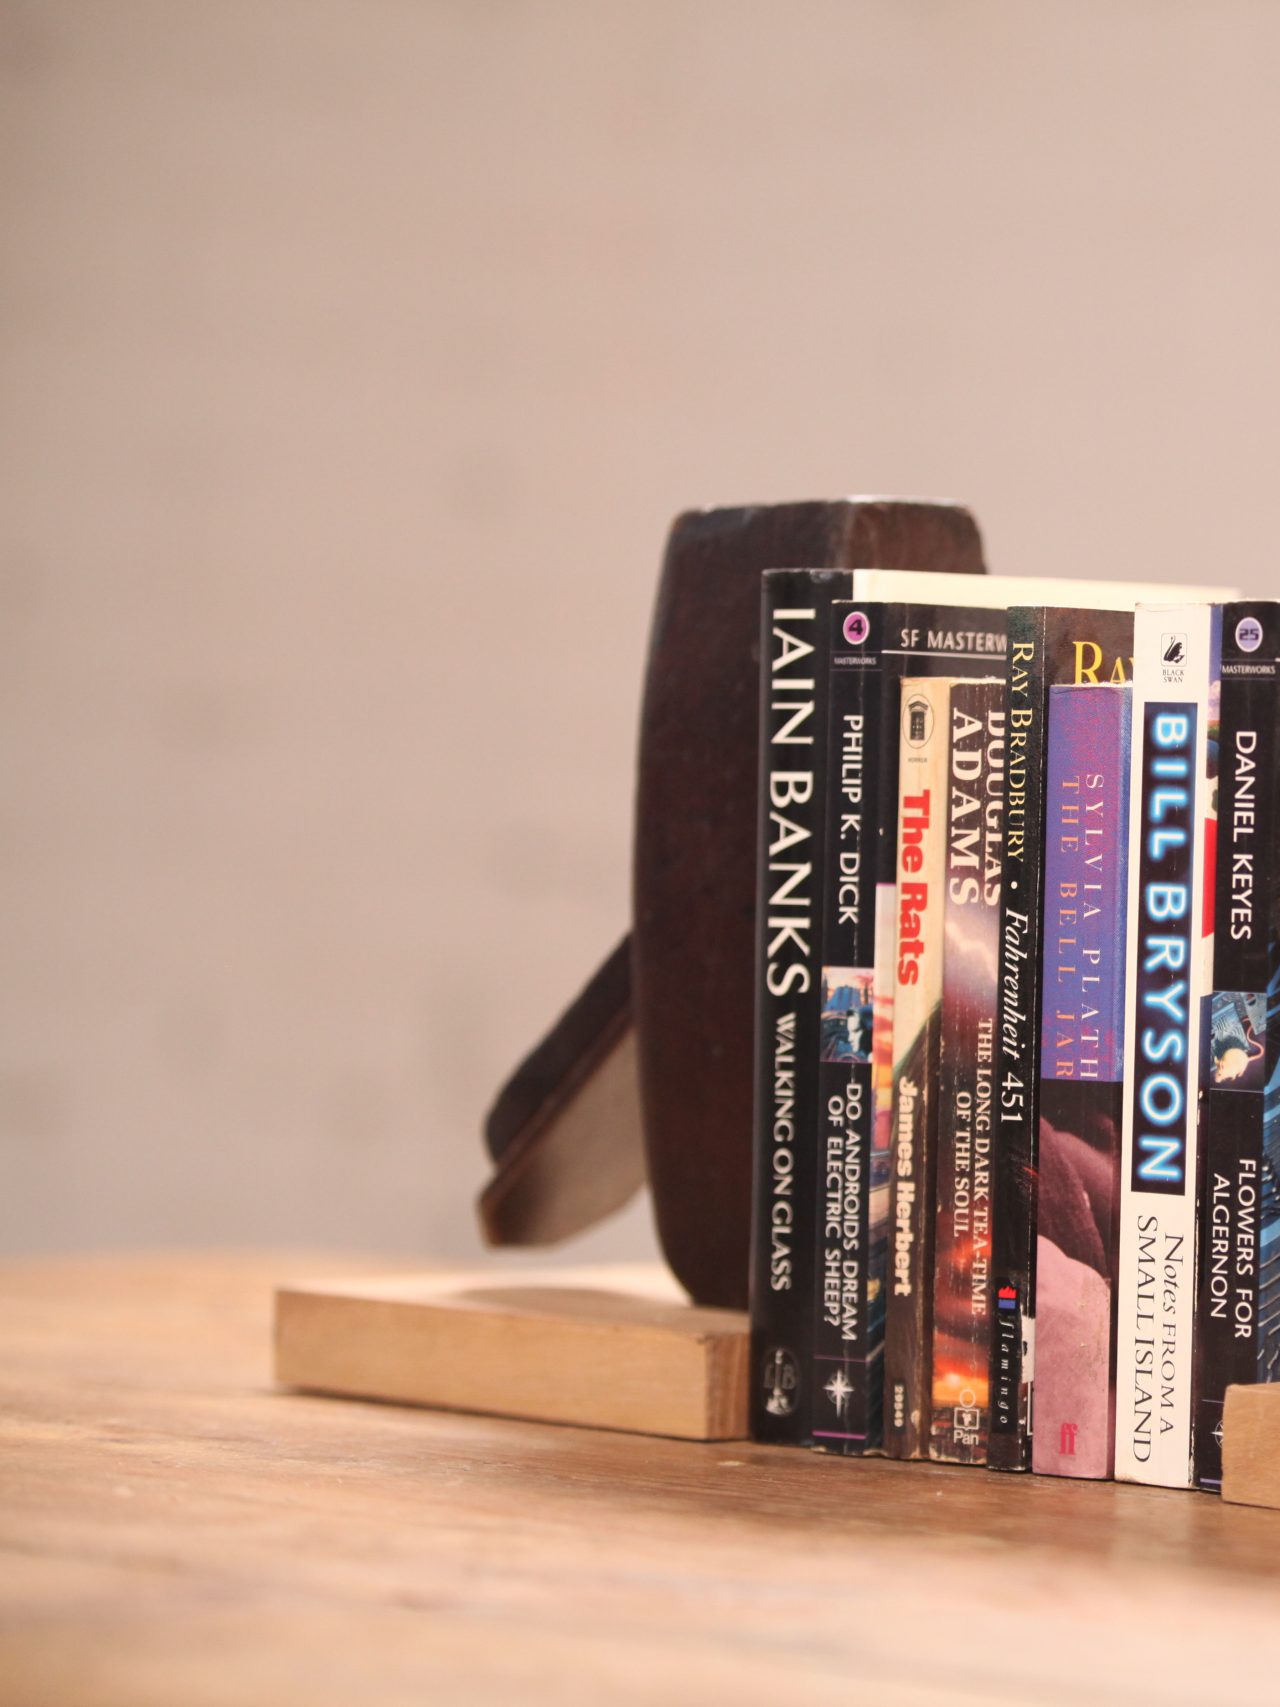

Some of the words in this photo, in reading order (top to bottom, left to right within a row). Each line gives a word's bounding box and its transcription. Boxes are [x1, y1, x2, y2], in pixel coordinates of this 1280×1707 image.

[849, 619, 863, 635] 4
[901, 629, 920, 648] SF
[1222, 665, 1276, 675] MASTERWORKS
[1239, 628, 1259, 640] 25
[770, 608, 816, 745] IAIN
[841, 714, 864, 803] PHILIP
[1151, 714, 1188, 858] BILL
[1233, 731, 1257, 843] DANIEL
[840, 814, 862, 839] K.
[901, 789, 931, 873] The
[949, 707, 983, 906] ADAMS
[984, 709, 1007, 906] DOUGLAS
[1061, 775, 1080, 853] THE
[1083, 774, 1104, 919] SYLVIA
[766, 771, 814, 997] BANKS
[838, 852, 861, 924] DICK
[1230, 854, 1254, 940] KEYES
[897, 882, 929, 986] Rats
[1058, 882, 1078, 983] BELL
[1001, 907, 1029, 1060] Fahrenheit
[1080, 949, 1100, 1079] PLATH
[976, 1018, 993, 1062] THE
[1055, 1010, 1075, 1077] JAR
[1138, 883, 1188, 1181] BRYSON
[773, 1012, 797, 1143] WALKING
[827, 1095, 844, 1127] OF
[846, 1084, 863, 1120] DO
[955, 1091, 972, 1123] OF
[975, 1064, 992, 1131] LONG
[1000, 1072, 1025, 1123] 451
[897, 1076, 918, 1177] James
[955, 1126, 971, 1165] THE
[973, 1134, 991, 1202] DARK
[773, 1147, 795, 1196] ON
[825, 1137, 844, 1239] ELECTRIC
[842, 1128, 862, 1250] ANDROIDS
[953, 1169, 970, 1238] SOUL
[770, 1201, 793, 1291] GLASS
[894, 1181, 916, 1297] Herbert
[971, 1205, 989, 1316] TEA-TIME
[1210, 1172, 1231, 1319] ALGERNON
[1236, 1158, 1257, 1276] FLOWERS
[823, 1248, 842, 1327] SHEEP?
[841, 1260, 859, 1341] DREAM
[1136, 1215, 1159, 1330] SMALL
[1161, 1232, 1184, 1315] Notes
[1234, 1288, 1253, 1339] FOR
[997, 1315, 1014, 1424] flamingo
[1132, 1338, 1156, 1463] ISLAND
[1160, 1319, 1177, 1411] FROM
[954, 1430, 979, 1446] Pan
[1160, 1418, 1175, 1434] A
